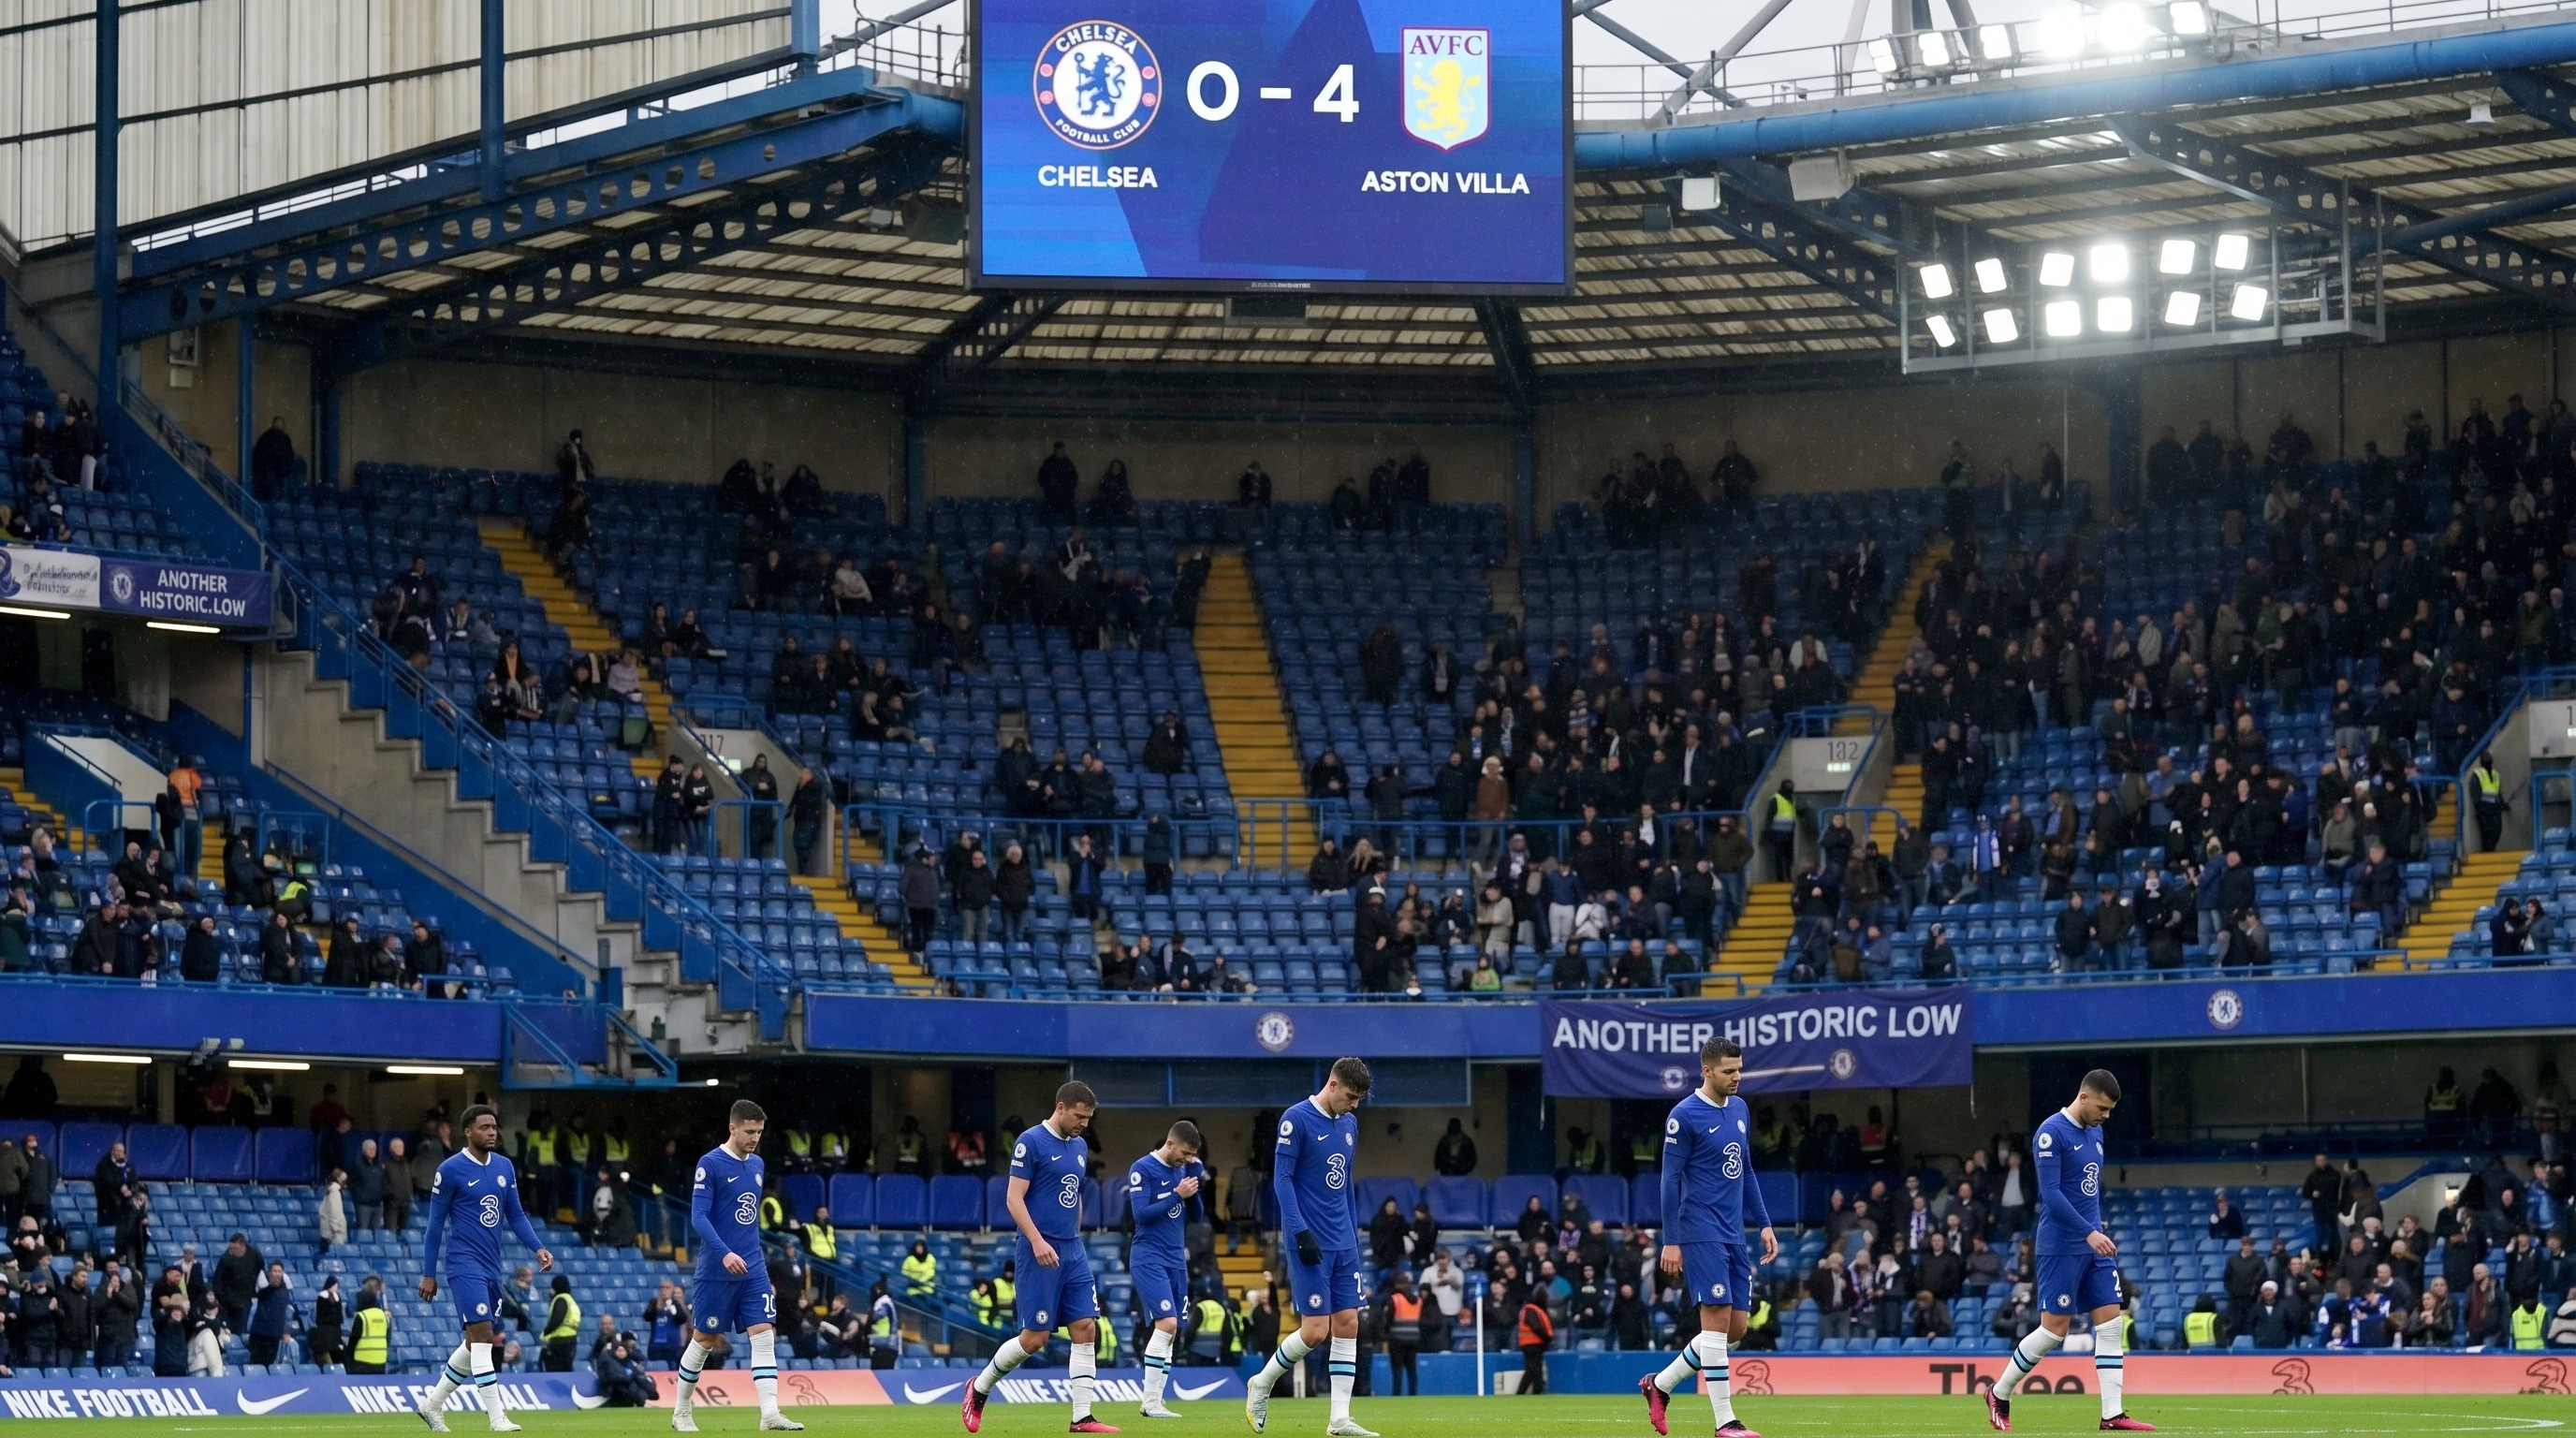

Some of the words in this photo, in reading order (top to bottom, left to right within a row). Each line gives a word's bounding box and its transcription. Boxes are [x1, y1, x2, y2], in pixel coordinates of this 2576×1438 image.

[1055, 24, 1138, 54] CHELSEA
[1409, 35, 1484, 56] AVFC
[1186, 60, 1240, 122] 0
[1313, 64, 1360, 123] 4
[1055, 118, 1110, 144] FOOTBALL
[1113, 119, 1141, 139] CLUB
[1037, 165, 1159, 188] CHELSEA
[1361, 170, 1450, 193] ASTON
[1456, 172, 1530, 195] VILLA
[156, 568, 228, 594] ANOTHER
[1552, 1017, 1715, 1054] ANOTHER
[1724, 1005, 1878, 1049] HISTORIC
[1888, 1004, 1963, 1039] LOW
[995, 1379, 1058, 1403] NIKE
[1929, 1363, 2086, 1395] Thee
[1, 1389, 79, 1418] NIKE
[72, 1387, 219, 1417] FOOTBALL
[341, 1386, 419, 1414] NIKE
